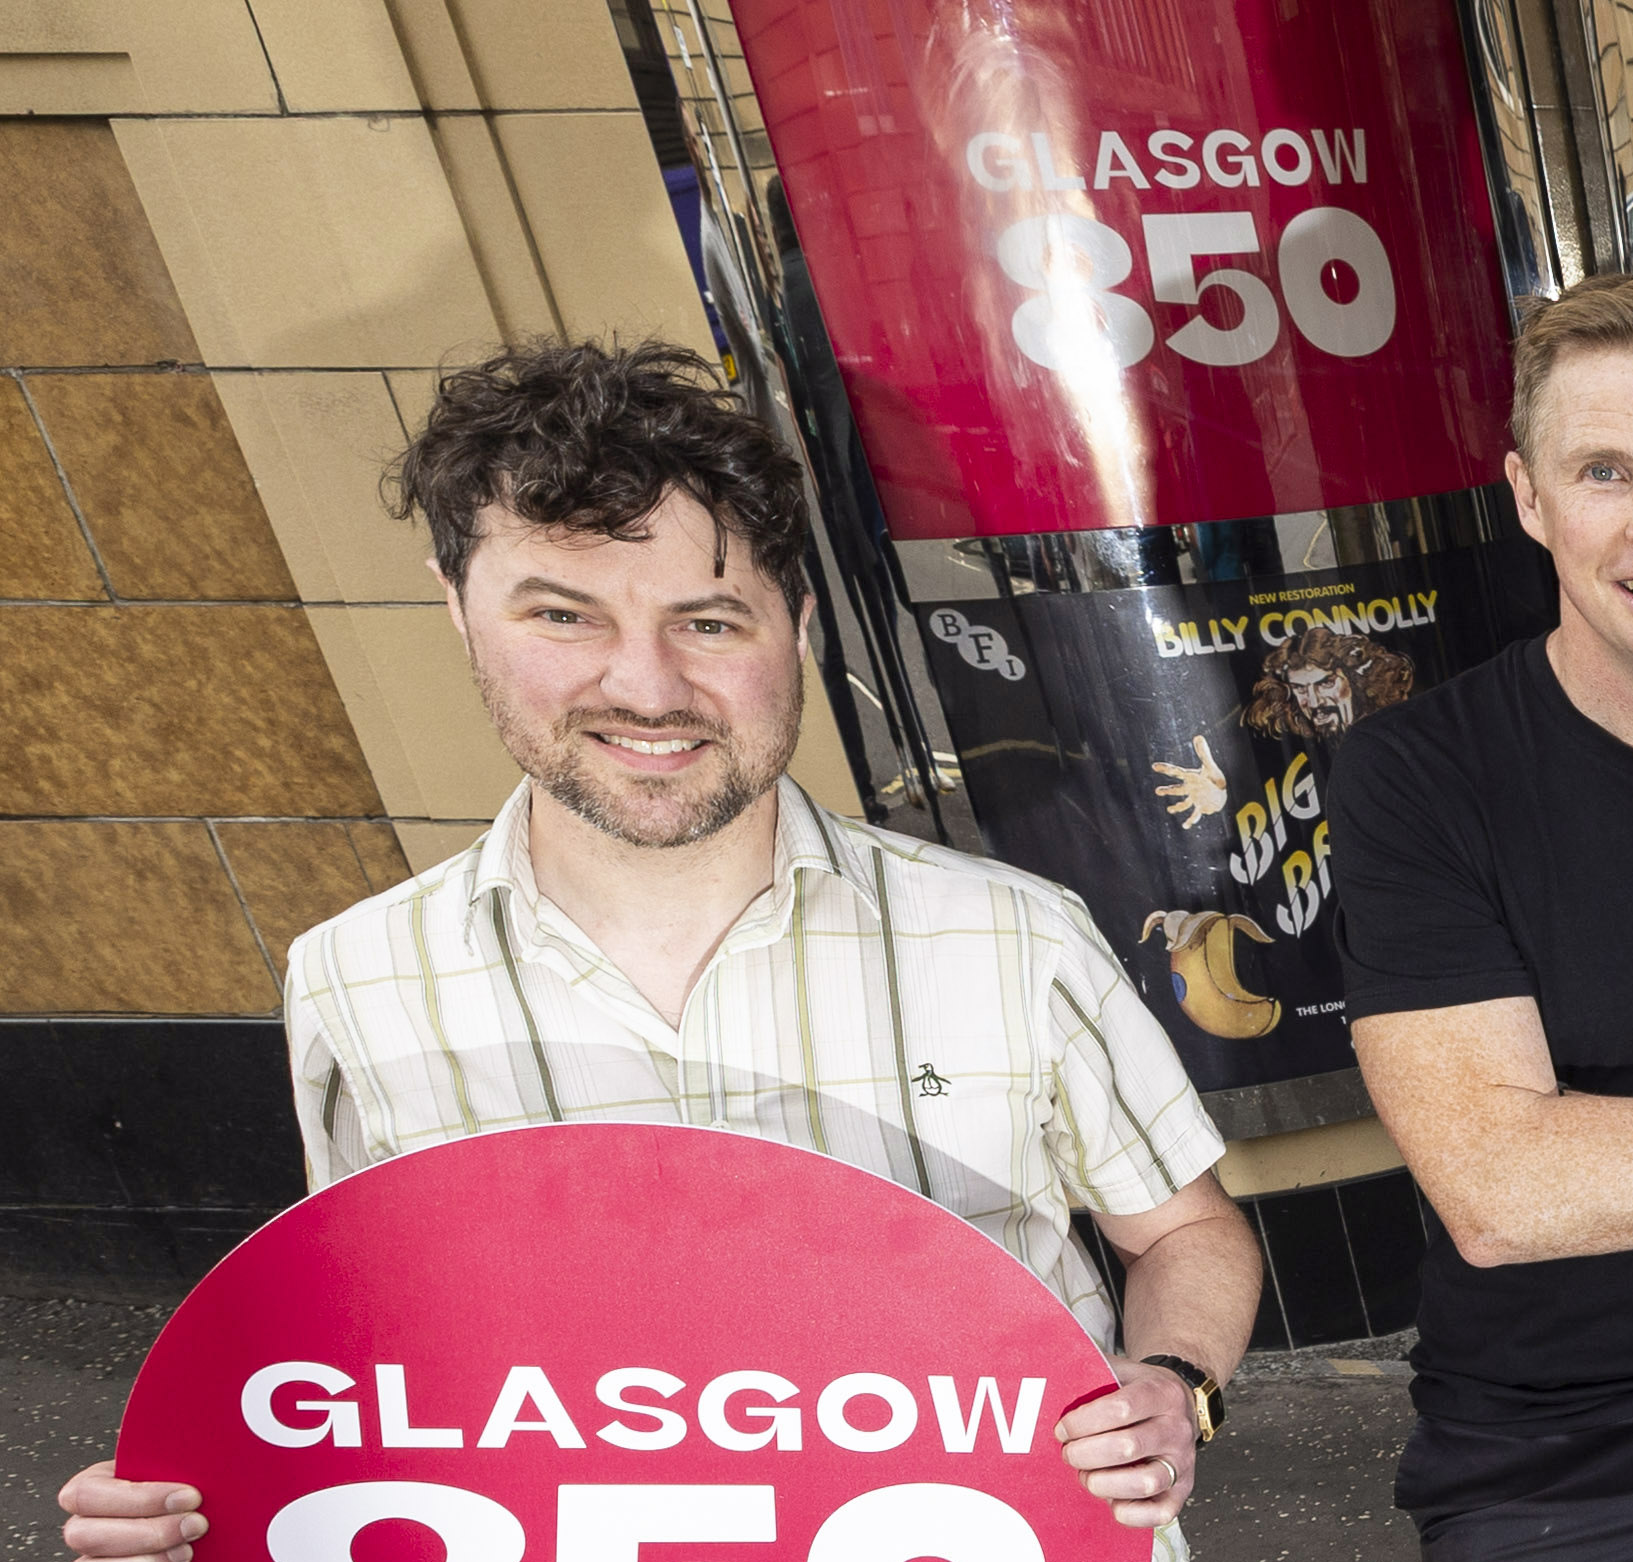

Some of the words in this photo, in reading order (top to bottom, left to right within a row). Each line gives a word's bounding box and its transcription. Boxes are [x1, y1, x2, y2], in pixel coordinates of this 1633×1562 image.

[966, 128, 1368, 192] GLASGOW
[1000, 206, 1397, 370] 850
[1152, 616, 1248, 658] BILLY
[1259, 590, 1438, 647] CONNOLLY
[1249, 592, 1276, 606] NEW
[1279, 583, 1355, 602] RESTORATION
[1229, 752, 1321, 886] BIG
[1295, 1005, 1318, 1016] THE
[240, 1361, 1047, 1454] GLASGOW
